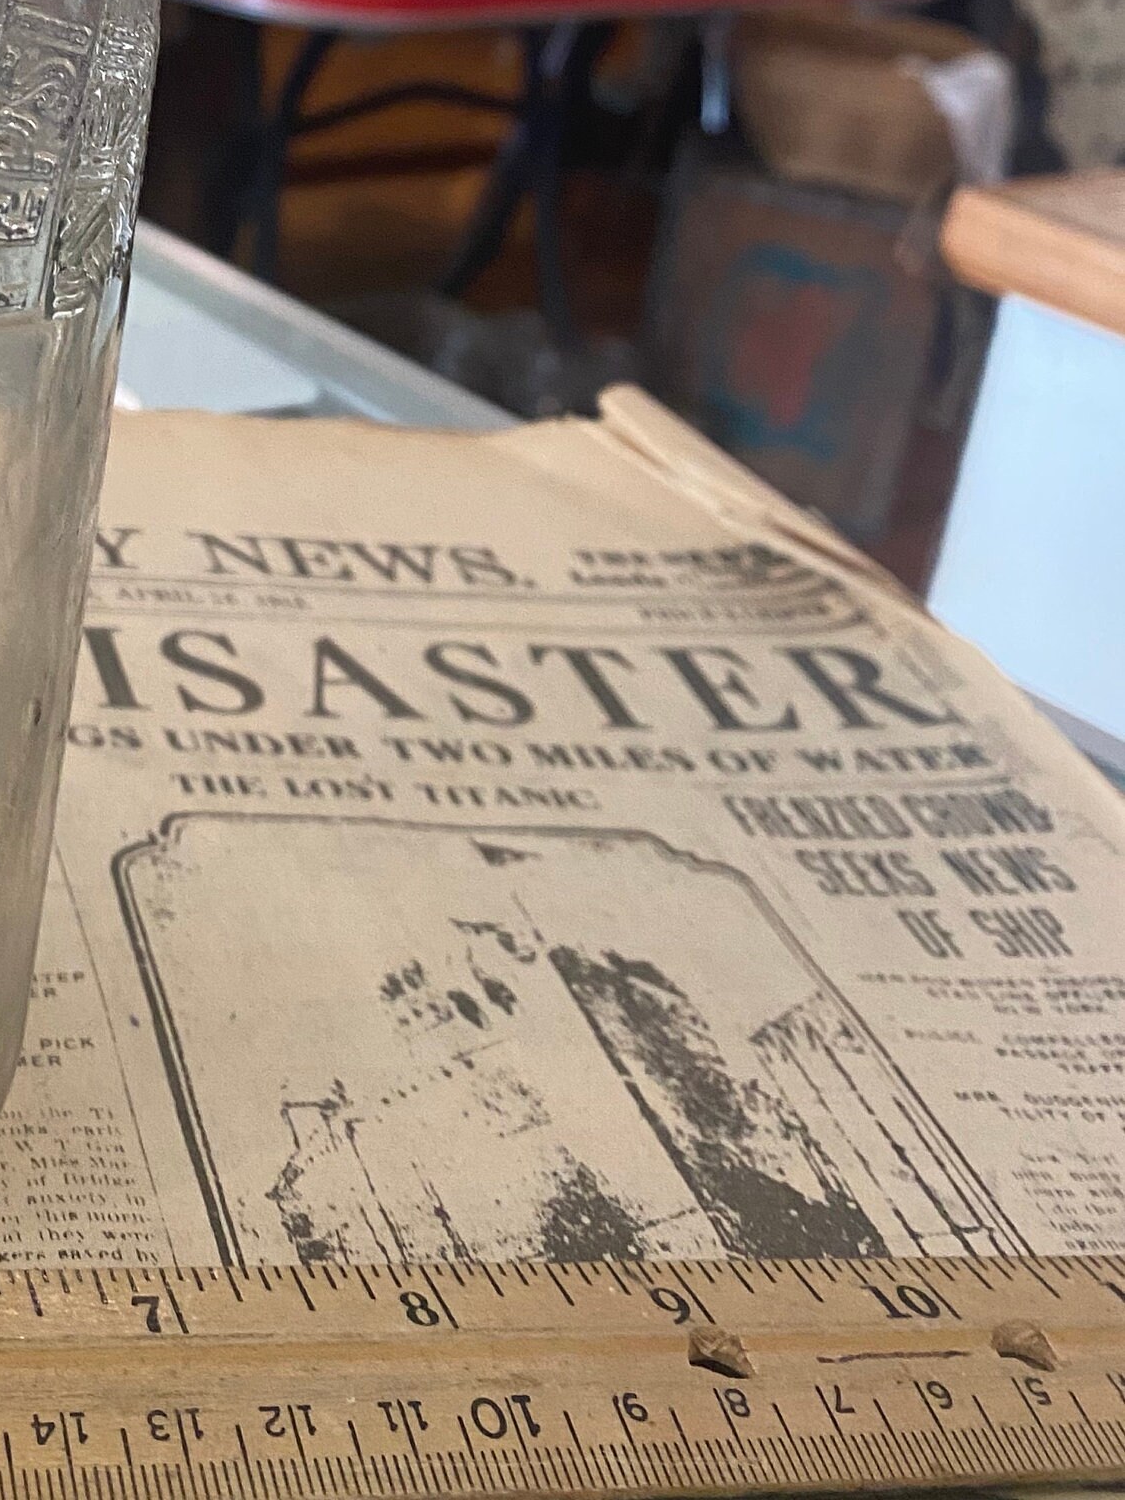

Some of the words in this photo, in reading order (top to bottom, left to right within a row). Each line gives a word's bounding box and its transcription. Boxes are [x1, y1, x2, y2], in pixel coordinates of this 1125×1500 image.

[186, 530, 537, 588] NEWS.
[163, 729, 362, 759] UNDER
[381, 735, 513, 767] TWO
[527, 742, 696, 773] MILES
[707, 746, 780, 774] OF
[797, 742, 997, 773] WATER
[169, 771, 264, 797] THE
[284, 774, 395, 802] LOST
[725, 794, 913, 839] FRENZIED
[795, 849, 936, 897] SEEKS
[940, 847, 1077, 895] NEWS
[895, 908, 963, 958] OF
[968, 906, 1073, 958] SHIP
[39, 1037, 95, 1049] PICK
[131, 1295, 163, 1334] 7
[399, 1291, 441, 1328] 8
[650, 1287, 692, 1325] 9
[861, 1284, 942, 1320] 10
[31, 1411, 89, 1447] 14
[146, 1407, 205, 1442] 13
[258, 1404, 318, 1438] 12
[377, 1399, 429, 1432] 11
[473, 1394, 543, 1440] 10
[622, 1392, 649, 1422] 9
[727, 1387, 752, 1418] 8
[833, 1384, 856, 1414] 7
[925, 1380, 954, 1410] 6
[1024, 1376, 1053, 1406] 5
